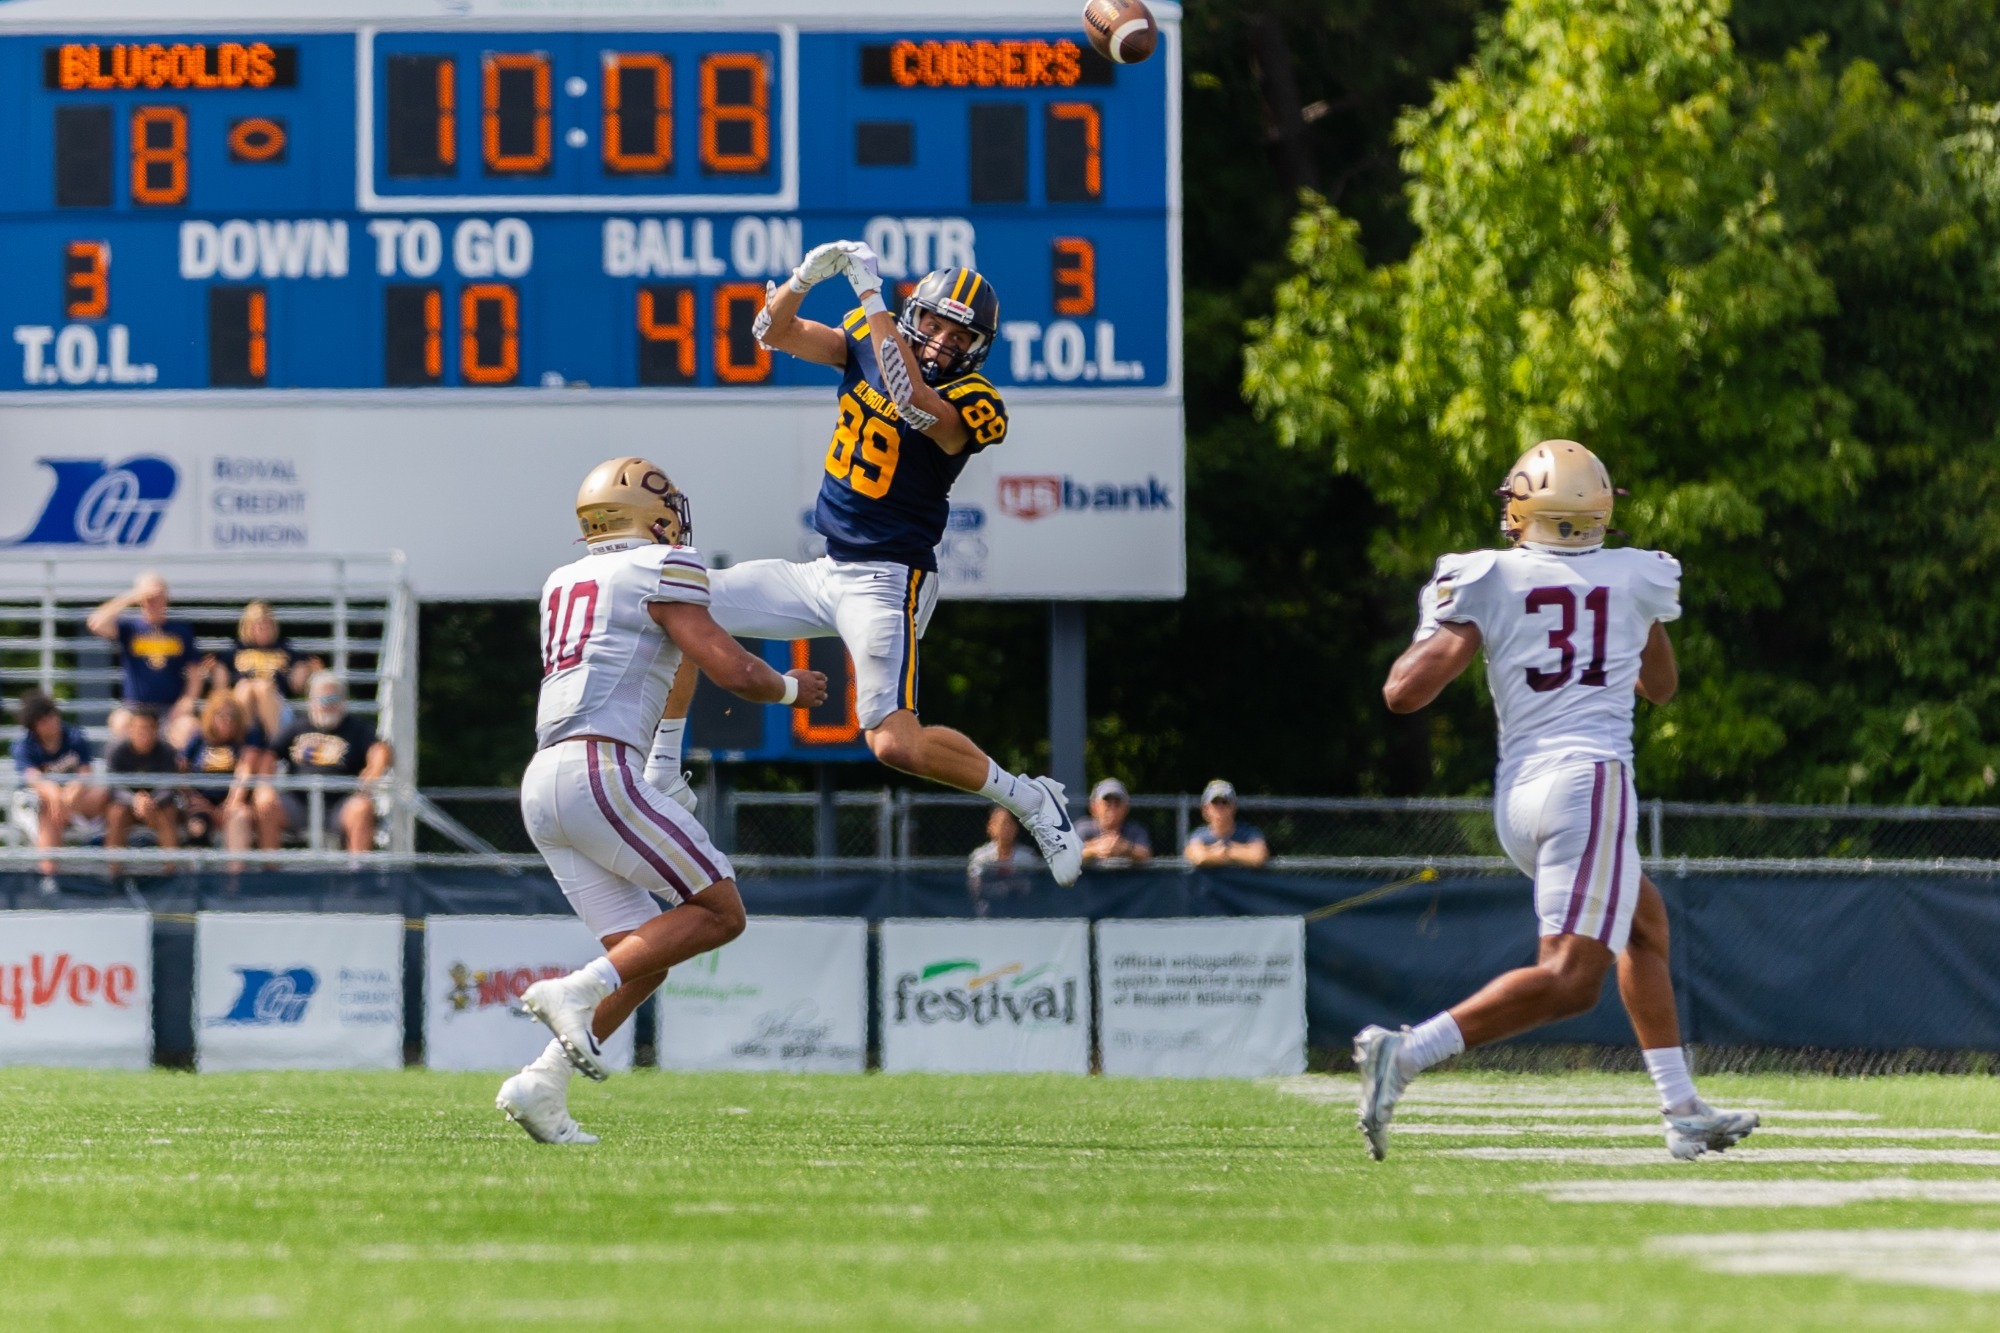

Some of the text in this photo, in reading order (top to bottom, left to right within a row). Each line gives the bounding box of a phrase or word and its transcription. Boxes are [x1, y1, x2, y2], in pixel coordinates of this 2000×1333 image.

[59, 43, 275, 89] BLUGOLDS
[890, 40, 1081, 87] COBBERS
[437, 54, 769, 170] 10:08
[132, 106, 188, 204] 8
[1052, 103, 1101, 194] 7
[180, 220, 349, 278] DOWN
[369, 218, 533, 277] TO GO
[603, 217, 802, 277] BALL ON
[865, 217, 976, 276] QTR
[1055, 237, 1096, 315] 3
[68, 242, 108, 317] 3
[13, 323, 158, 385] T.O.L.
[248, 292, 267, 376] 1
[424, 283, 519, 383] 10
[637, 283, 771, 382] 40
[1001, 320, 1145, 382] T.O.L.
[825, 393, 900, 500] 89
[962, 398, 1006, 444] 89
[213, 455, 299, 480] ROYAL
[212, 487, 305, 514] CREDIT
[214, 521, 308, 548] UNION
[542, 579, 600, 677] 10
[1525, 586, 1611, 692] 31
[895, 972, 1076, 1027] festival
